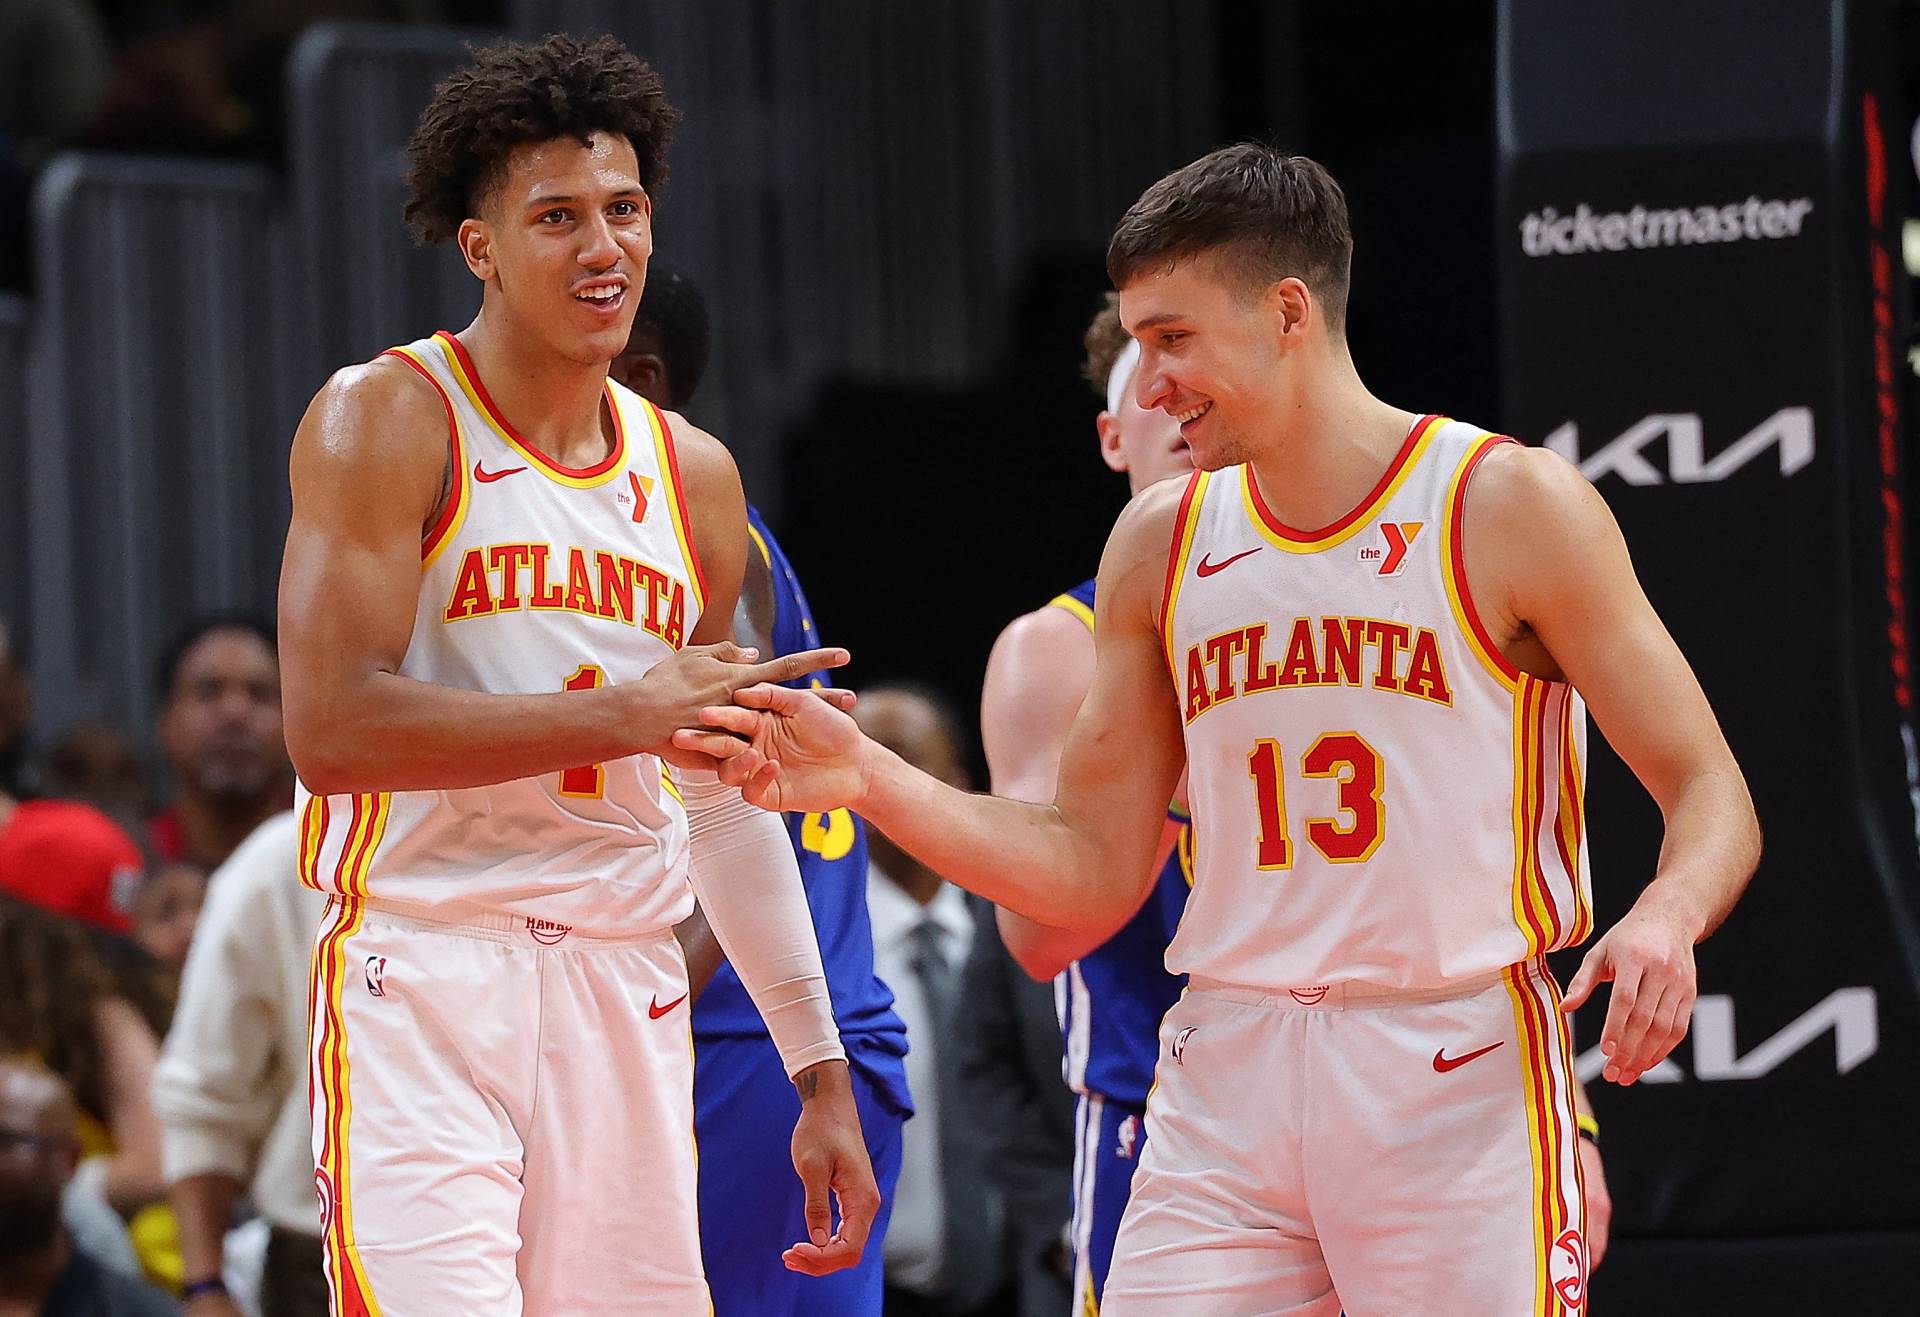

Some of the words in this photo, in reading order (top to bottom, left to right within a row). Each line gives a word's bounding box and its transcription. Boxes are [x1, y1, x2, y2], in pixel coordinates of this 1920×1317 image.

[1519, 195, 1812, 257] ticketmaster
[1543, 406, 1816, 486] KIA
[617, 492, 631, 505] the
[1360, 547, 1381, 560] the
[443, 543, 686, 655] ATLANTA
[1185, 616, 1454, 727] ATLANTA
[1248, 731, 1386, 871] 13
